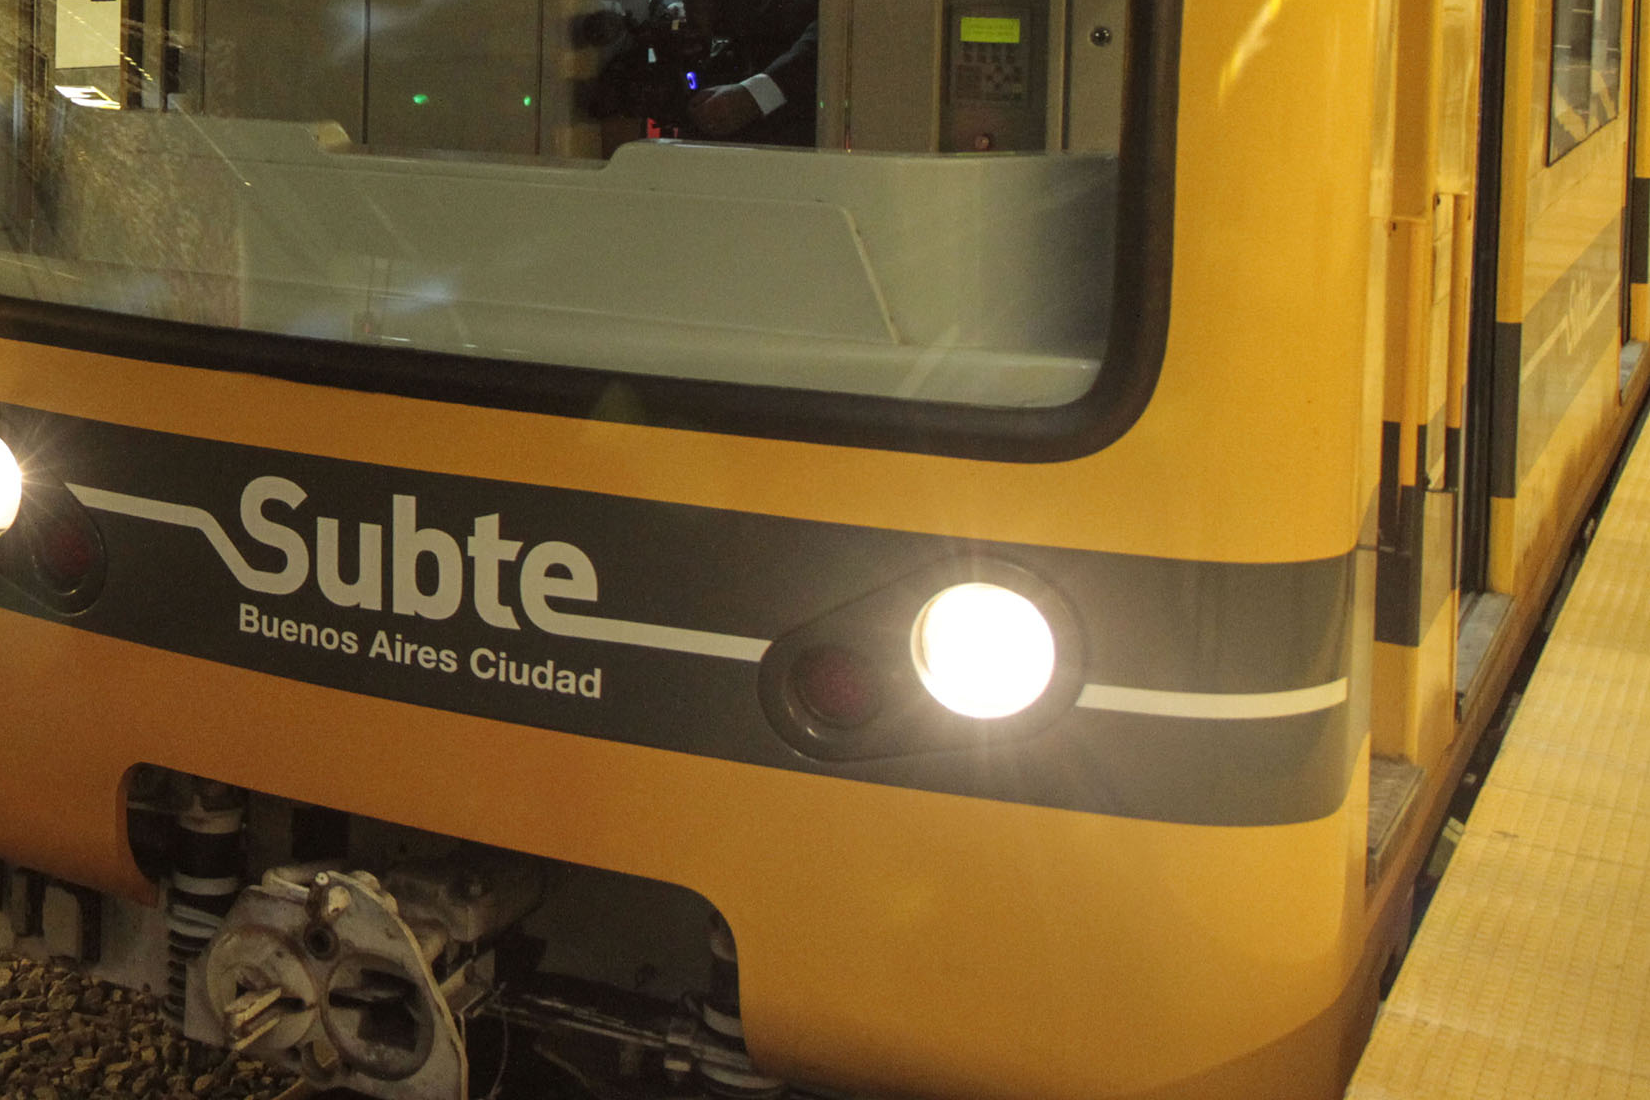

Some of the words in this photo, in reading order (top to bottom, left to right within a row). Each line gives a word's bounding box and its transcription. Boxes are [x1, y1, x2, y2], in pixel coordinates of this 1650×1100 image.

[239, 475, 599, 637] Subte
[239, 602, 359, 654] Buenos
[368, 629, 459, 674] Aires
[469, 647, 602, 699] Ciudad
